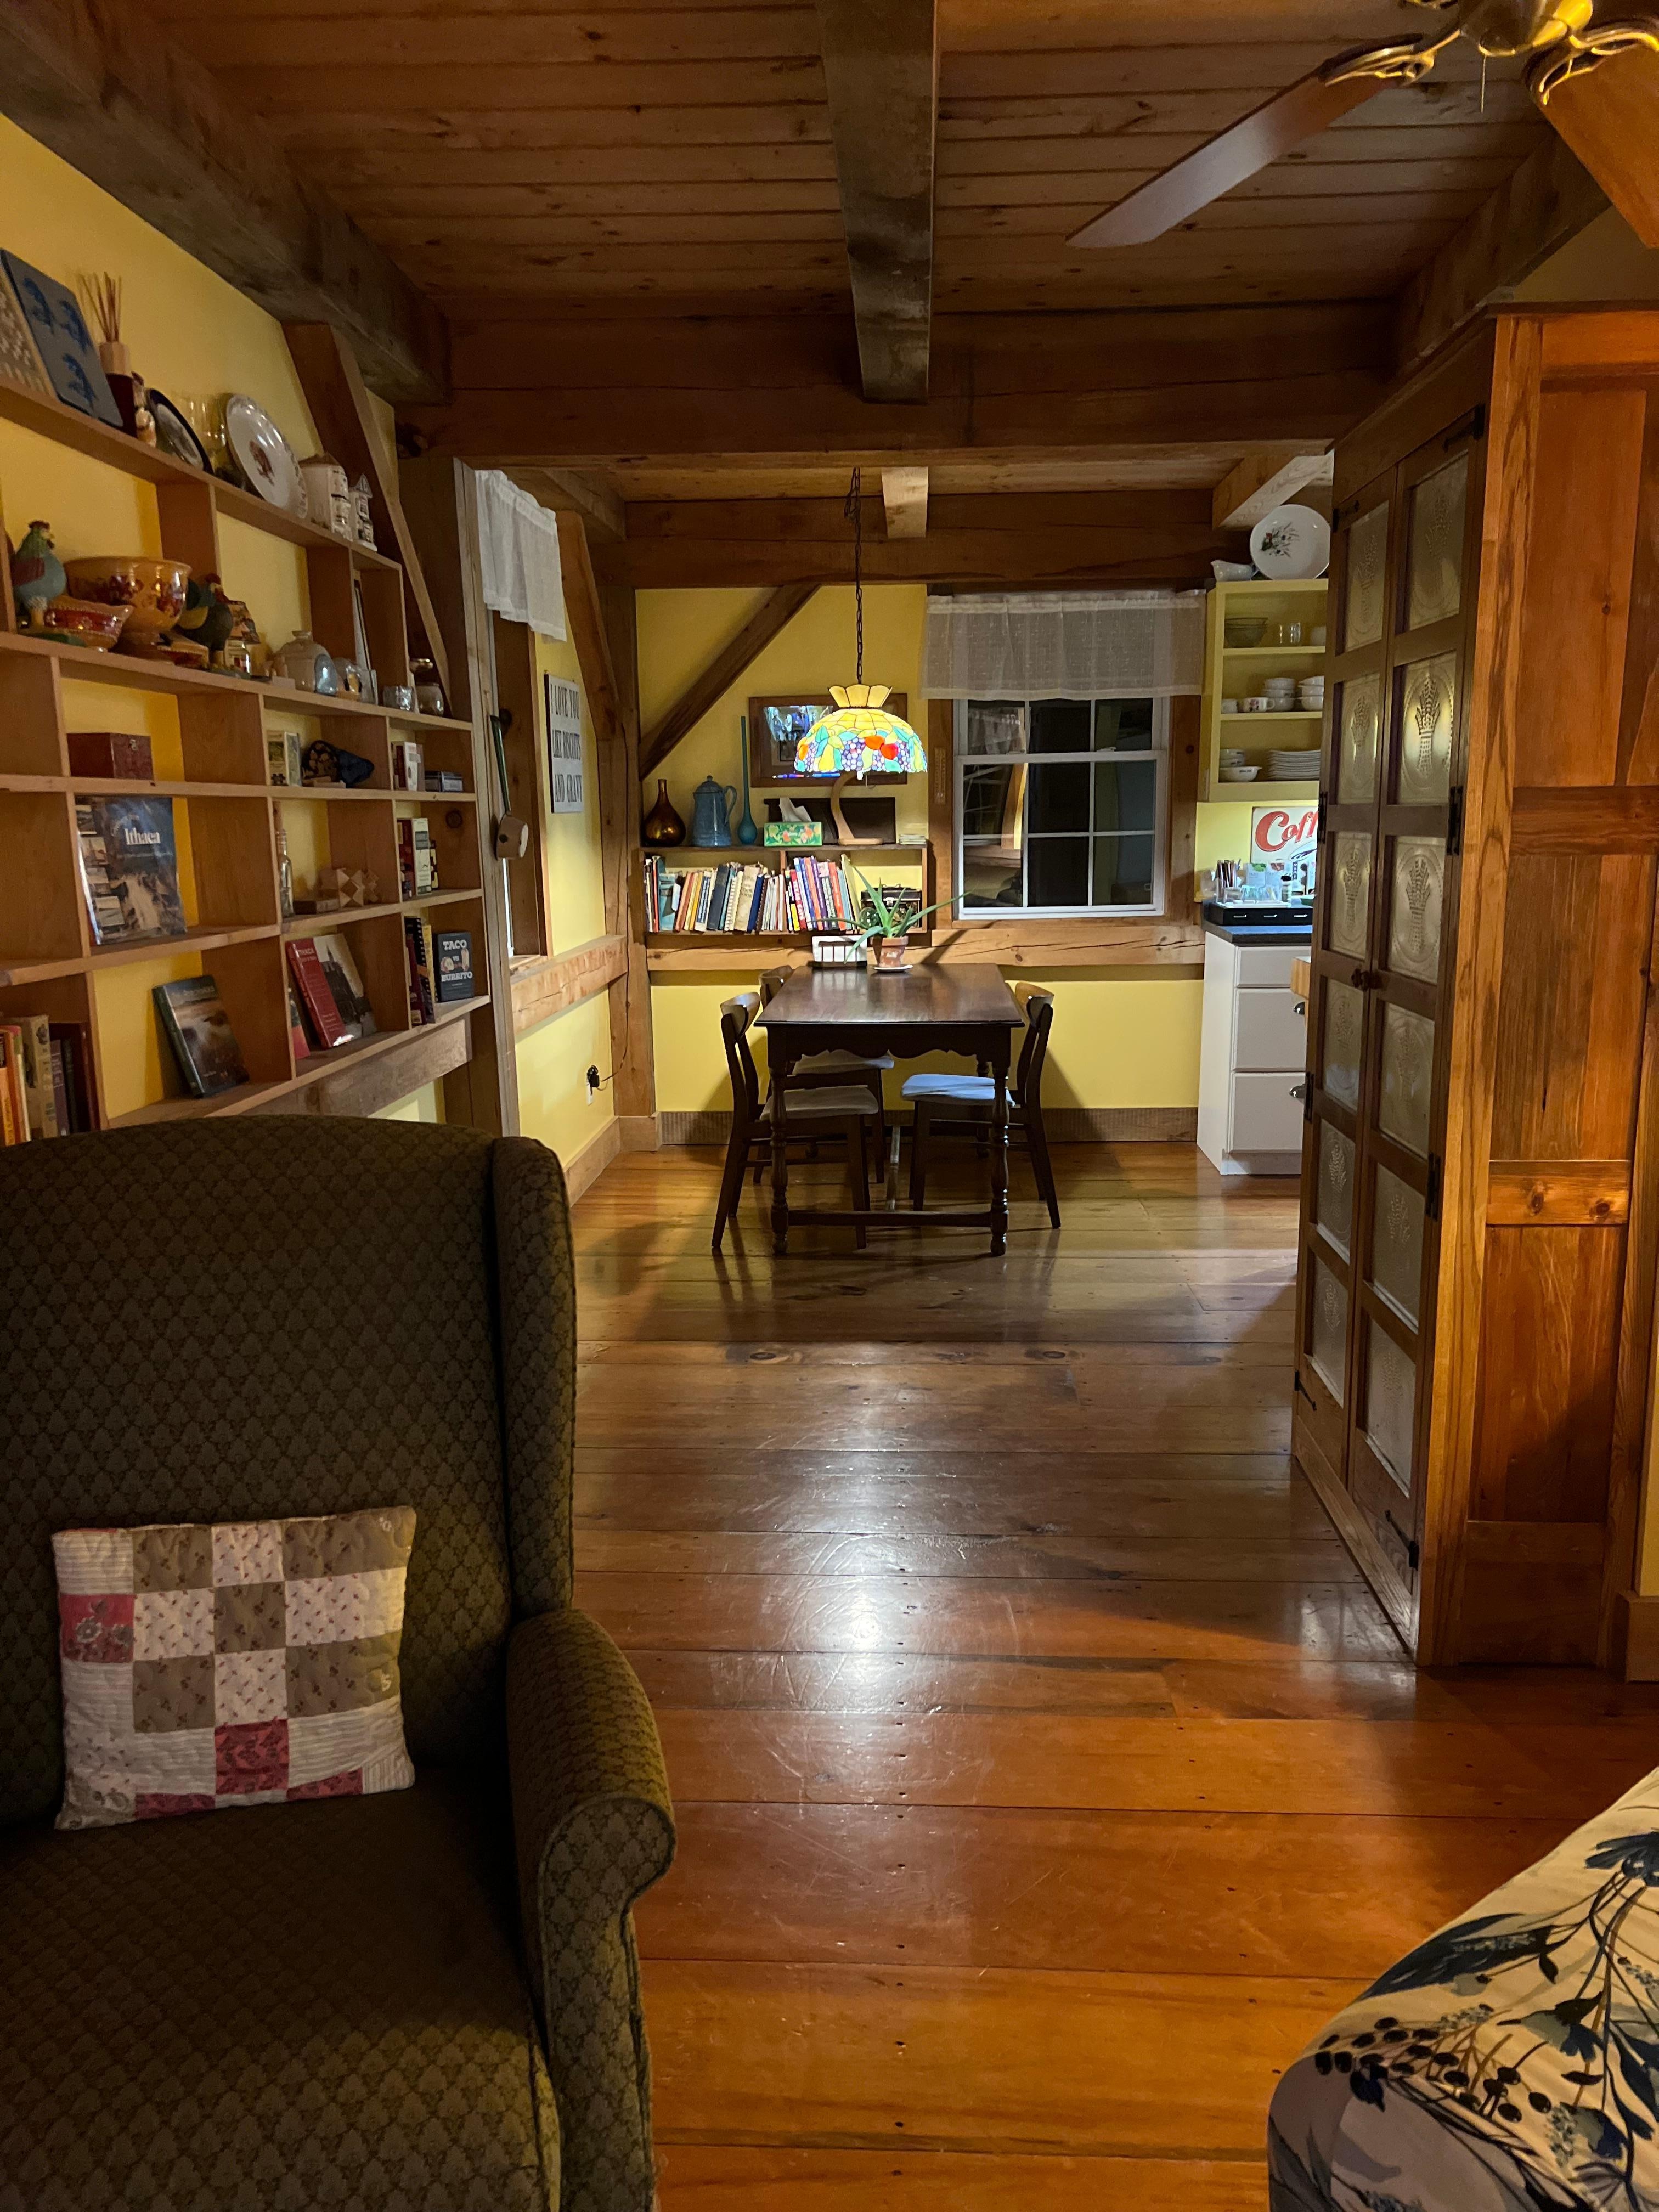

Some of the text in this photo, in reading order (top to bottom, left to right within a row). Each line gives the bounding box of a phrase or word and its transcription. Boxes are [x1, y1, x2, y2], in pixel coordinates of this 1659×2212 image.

[555, 684, 568, 718] LOVE
[569, 689, 579, 720] YOU
[555, 774, 582, 803] AND GRAVY
[124, 827, 161, 845] Ithaca
[443, 939, 467, 950] TACO
[441, 971, 472, 983] BURRITO
